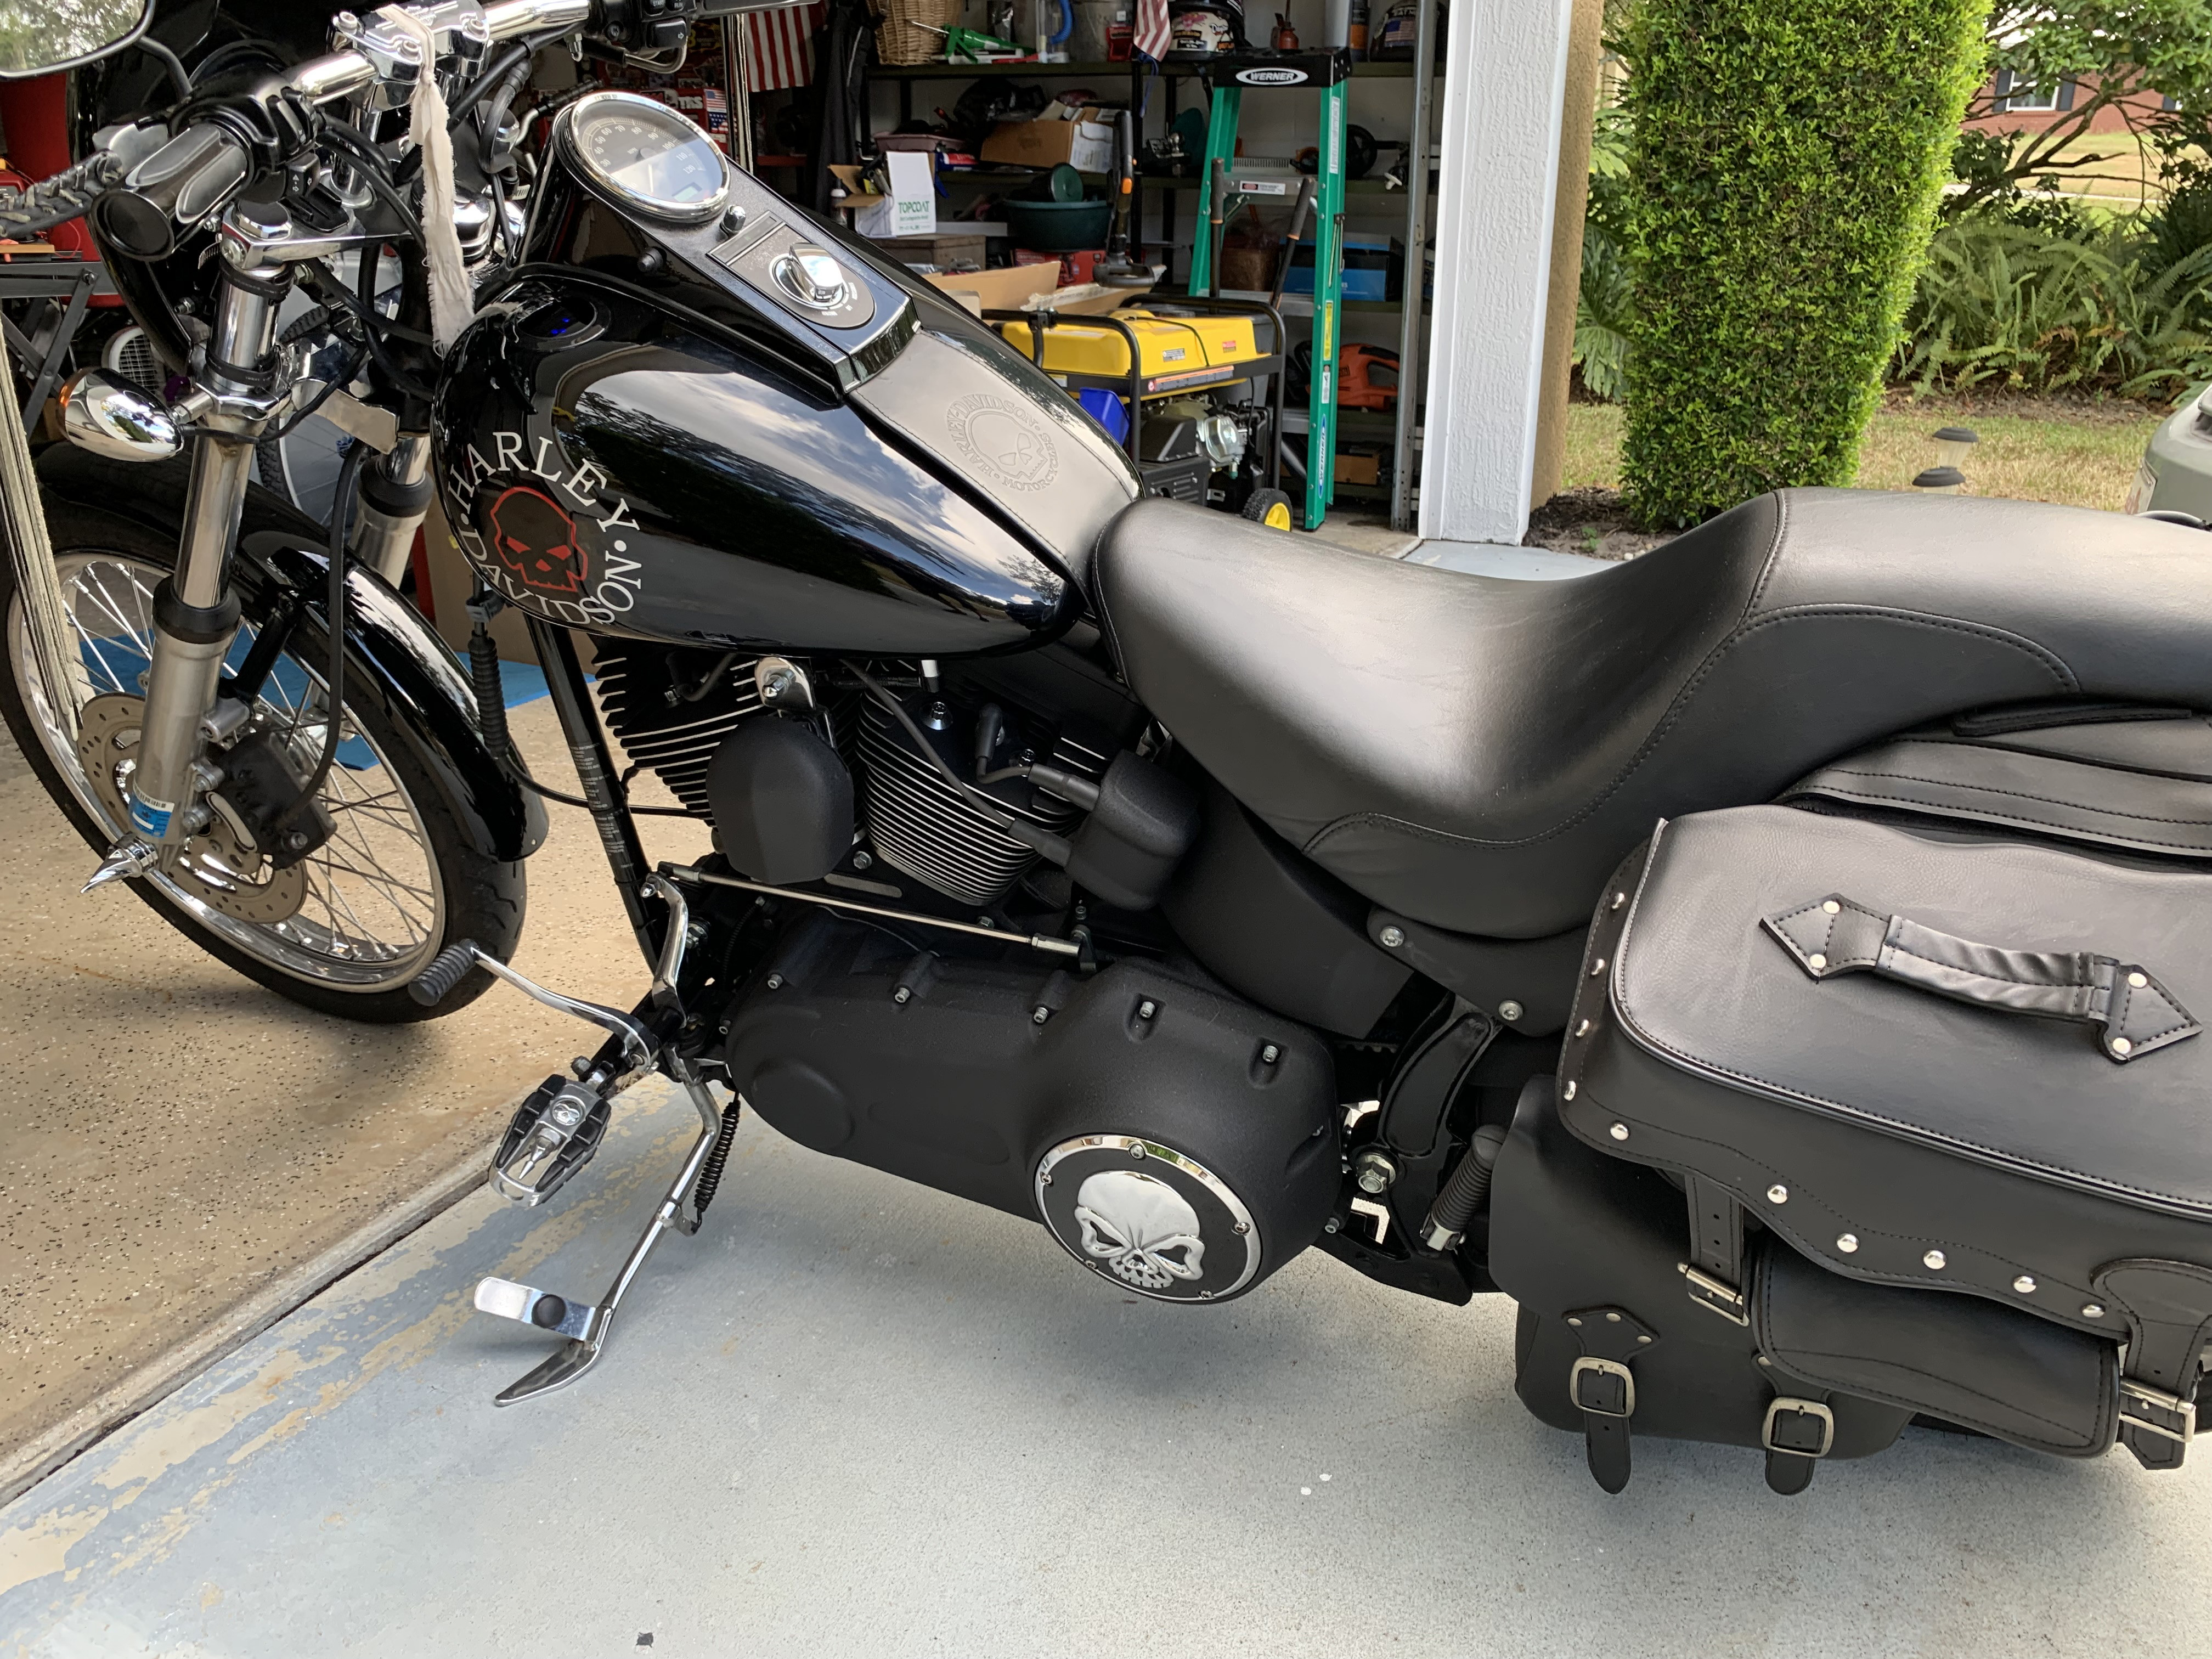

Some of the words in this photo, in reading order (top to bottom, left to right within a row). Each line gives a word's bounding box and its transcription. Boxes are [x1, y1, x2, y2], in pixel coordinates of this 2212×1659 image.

[1250, 72, 1294, 81] WERNER
[662, 141, 675, 150] 100
[676, 153, 688, 161] 110
[600, 159, 611, 167] 30
[683, 165, 696, 174] 120
[898, 201, 929, 213] TOPCOAT
[1002, 433, 1058, 492] MOTORCYCLES
[447, 431, 640, 533] HARLEY
